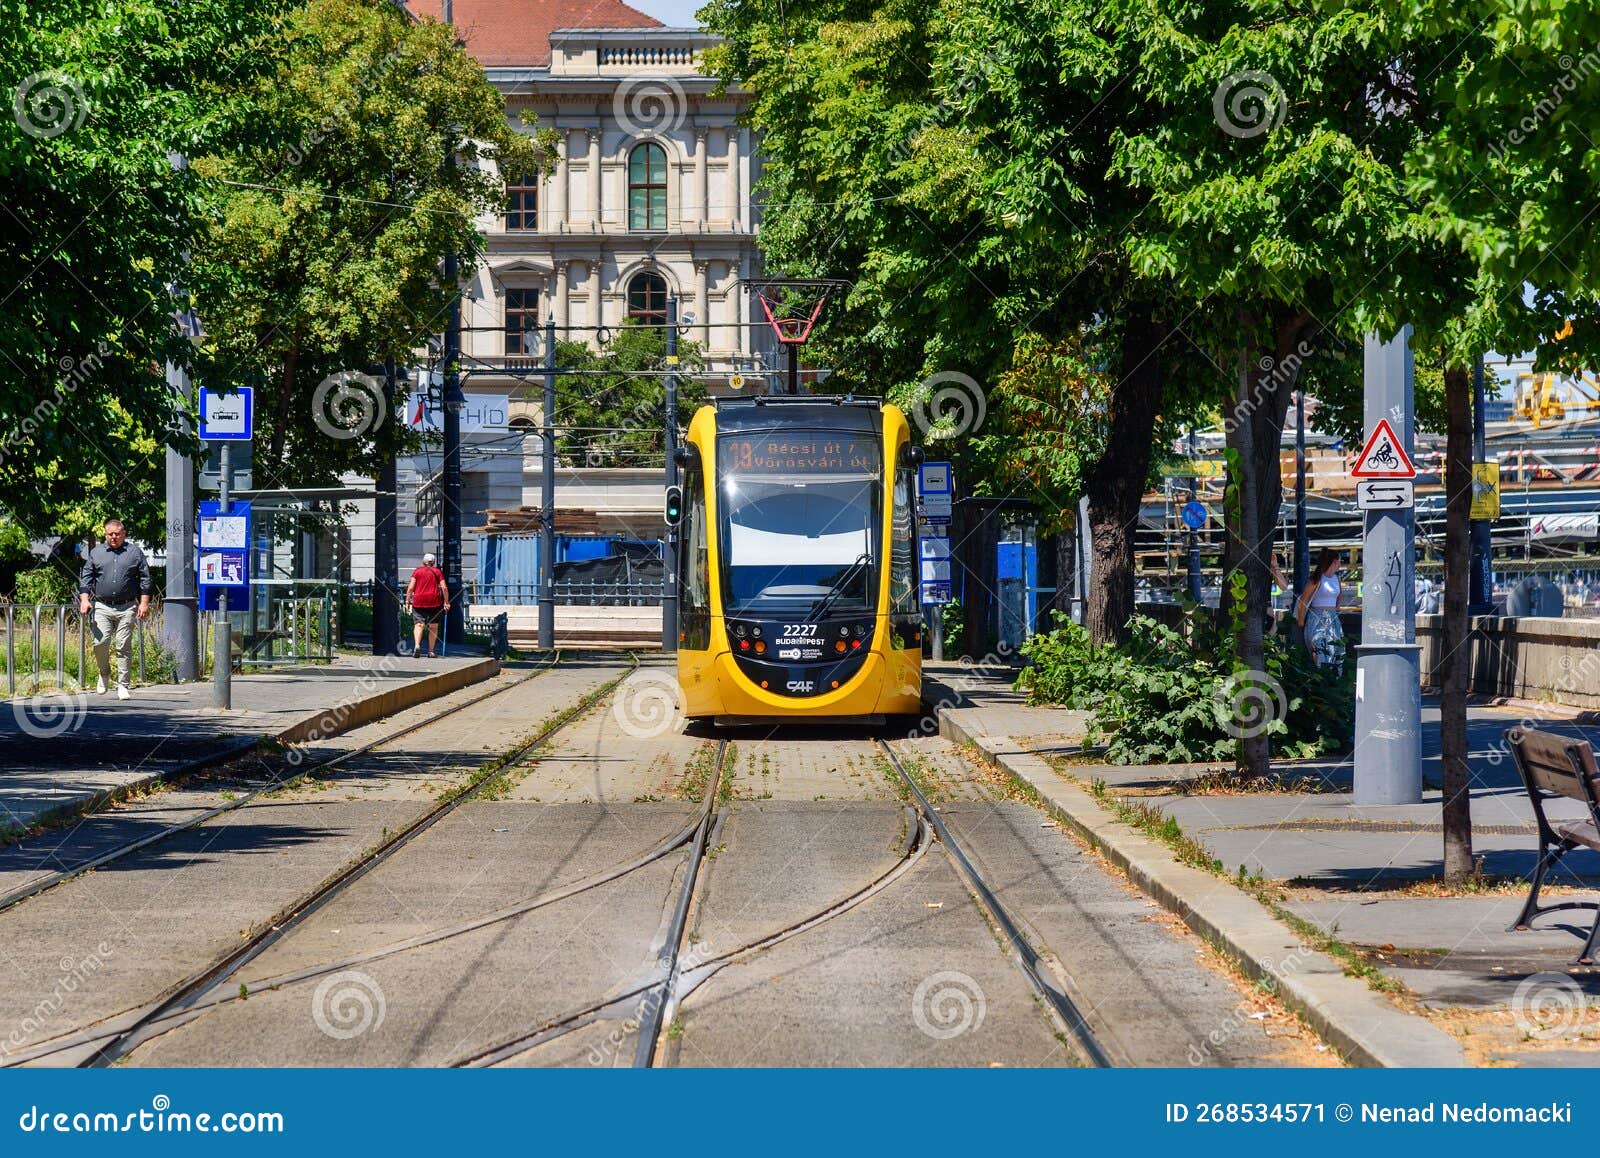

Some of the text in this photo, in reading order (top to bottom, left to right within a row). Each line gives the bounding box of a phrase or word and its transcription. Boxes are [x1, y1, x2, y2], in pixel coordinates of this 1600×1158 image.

[767, 442, 817, 454] Bécsi
[823, 441, 841, 454] út
[783, 624, 818, 637] 2227
[786, 681, 814, 692] CAF
